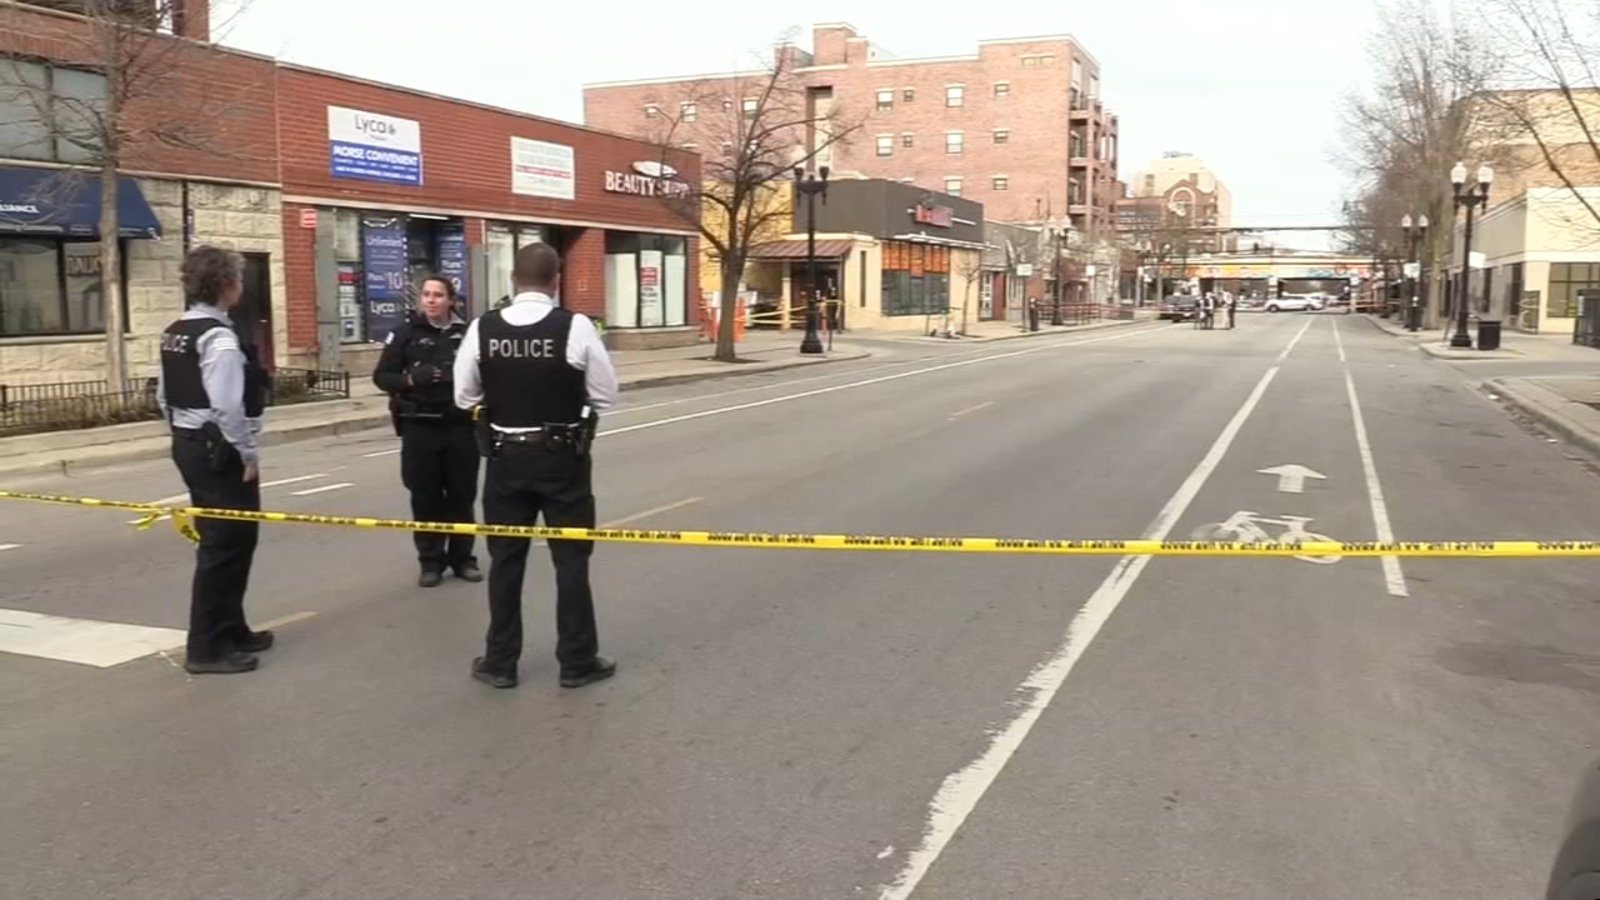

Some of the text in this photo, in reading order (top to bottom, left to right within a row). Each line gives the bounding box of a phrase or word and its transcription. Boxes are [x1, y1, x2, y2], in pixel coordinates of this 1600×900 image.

[355, 113, 387, 135] Lyca
[604, 170, 656, 196] BEAUTY
[488, 338, 555, 358] POLICE
